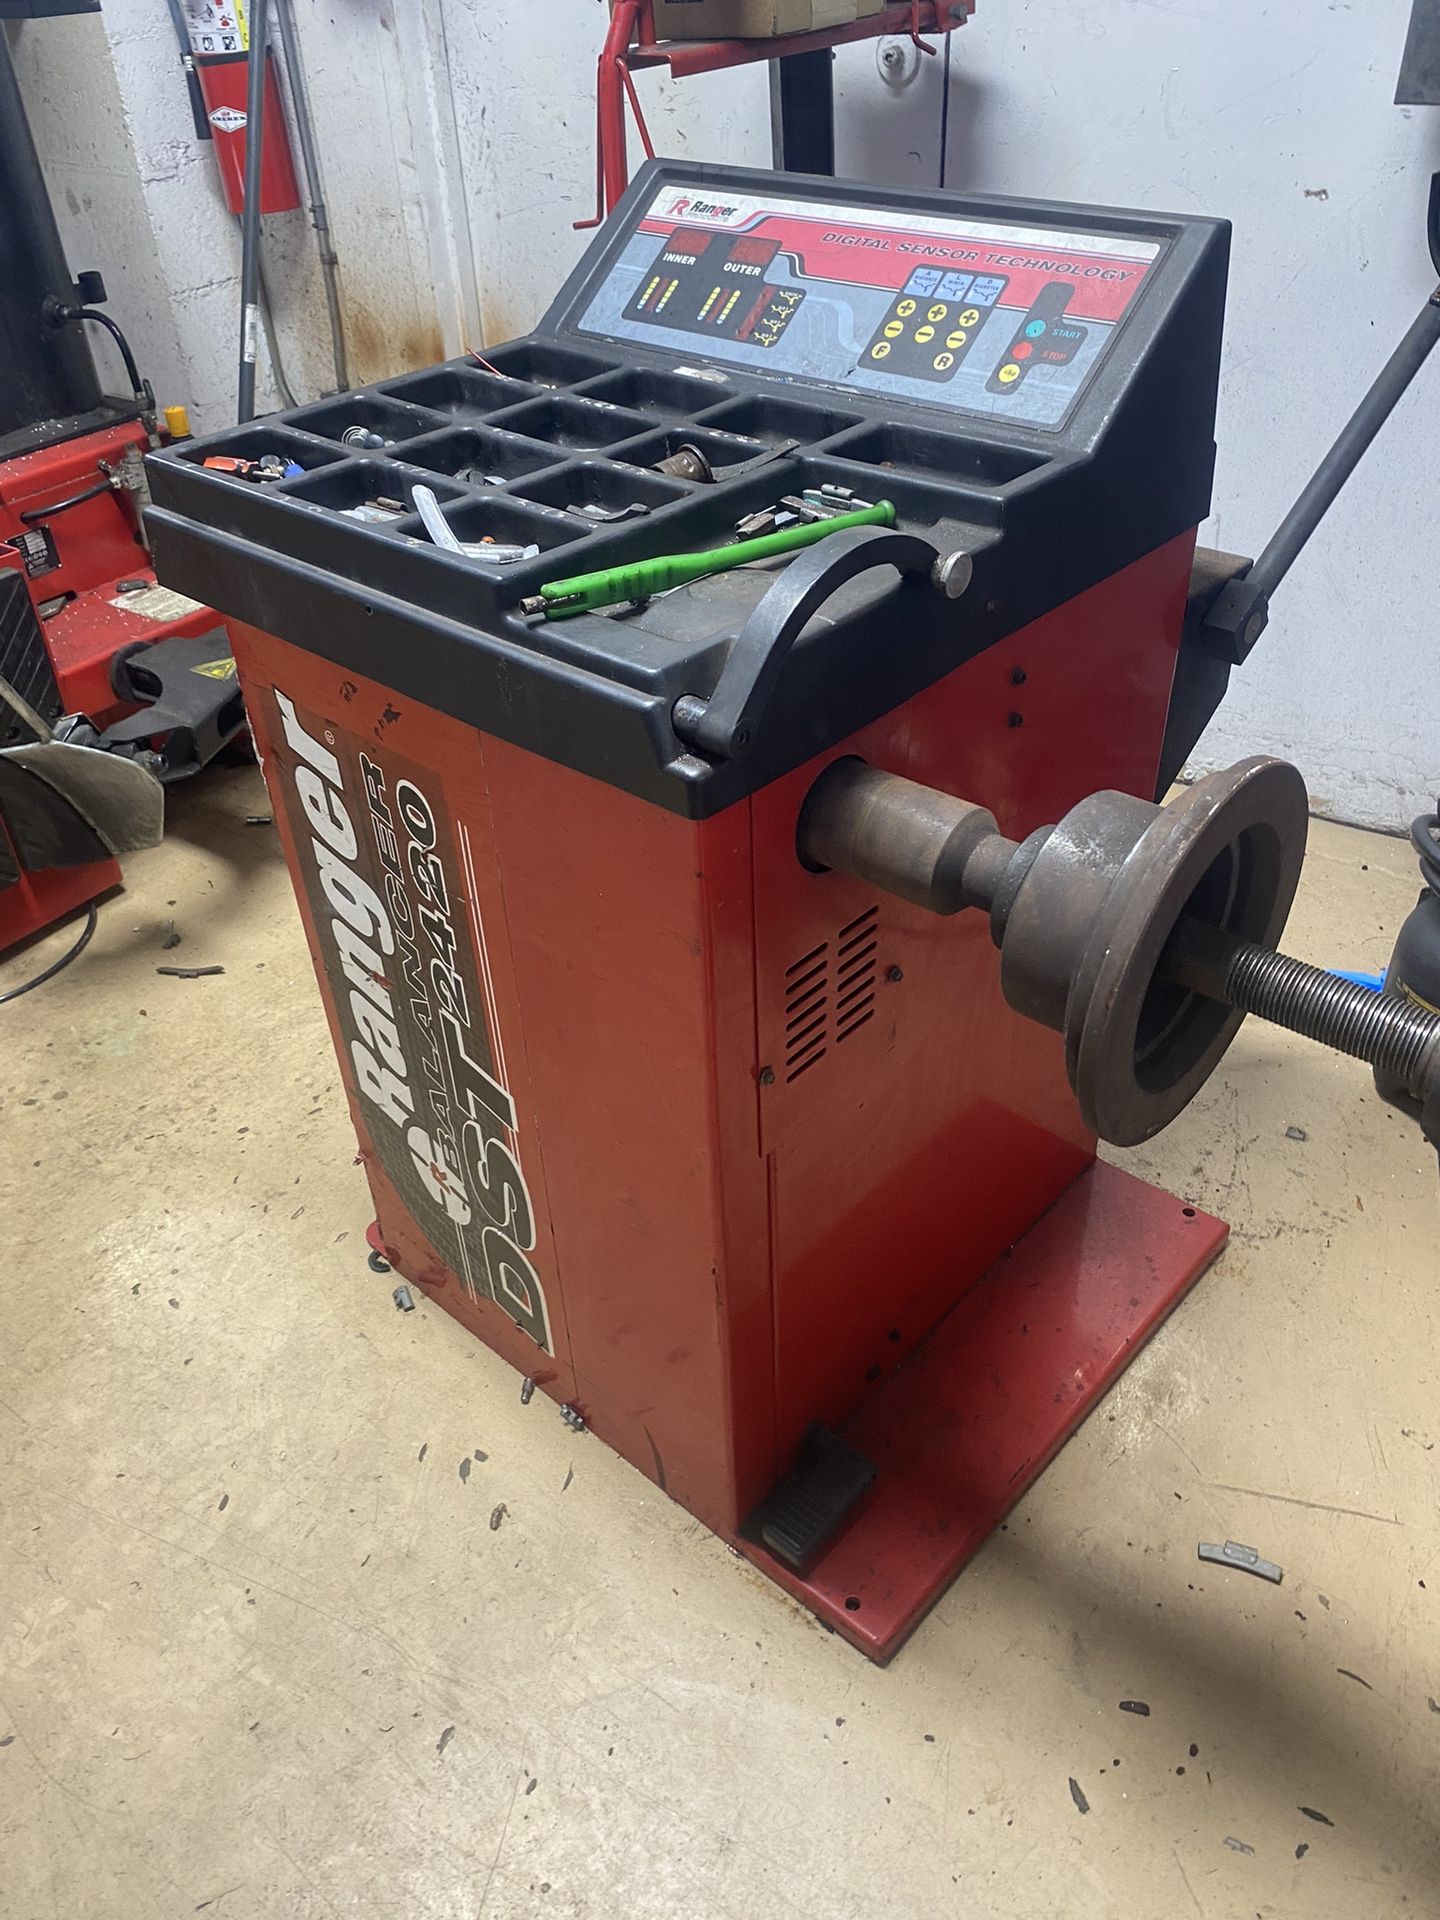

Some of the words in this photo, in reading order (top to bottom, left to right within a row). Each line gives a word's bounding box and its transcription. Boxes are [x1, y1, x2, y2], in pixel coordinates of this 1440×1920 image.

[689, 200, 738, 218] Ranger
[662, 252, 697, 266] INNER
[821, 232, 890, 250] DIGITAL
[896, 242, 979, 261] SENSOR
[985, 252, 1136, 281] TECHNOLOGY
[723, 262, 762, 277] OUTER
[1051, 328, 1081, 339] START
[876, 345, 888, 356] F
[1041, 350, 1067, 361] STOP
[937, 355, 951, 367] R
[359, 751, 465, 1188] BALANCER
